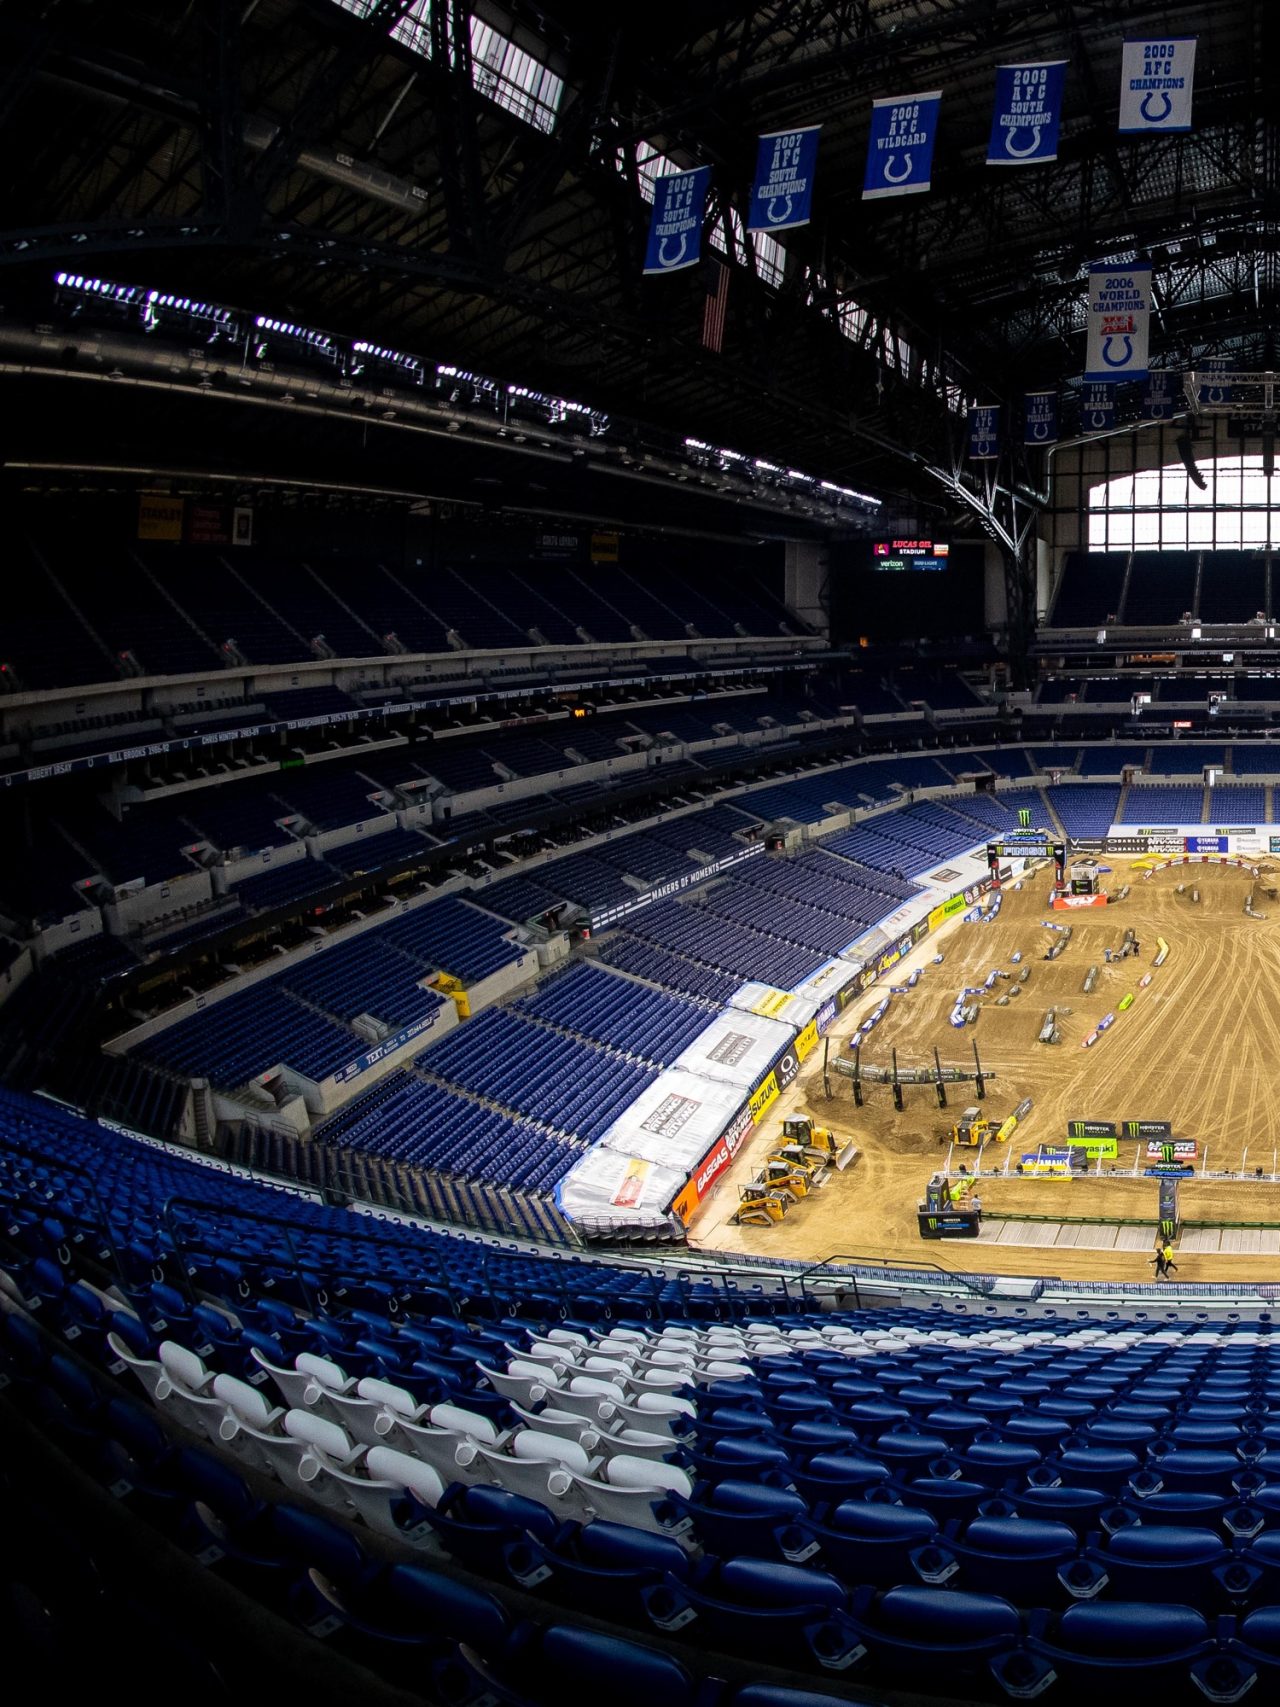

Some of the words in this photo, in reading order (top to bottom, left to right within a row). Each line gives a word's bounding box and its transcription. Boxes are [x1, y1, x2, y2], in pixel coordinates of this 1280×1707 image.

[1144, 45, 1174, 58] 2009
[1144, 61, 1171, 75] AFC
[1014, 69, 1047, 84] 2009
[1130, 78, 1184, 90] CHAMPIONS
[1012, 85, 1046, 101] AFC
[891, 105, 919, 121] 2008
[1010, 101, 1043, 114] SOUTH
[1000, 112, 1052, 127] CHAMPIONS
[889, 120, 917, 136] AFC
[774, 134, 802, 150] 2007
[877, 132, 926, 149] WILDCARD
[771, 147, 800, 169] AFC
[769, 167, 797, 183] SOUTH
[668, 176, 694, 193] 2006
[757, 178, 806, 199] CHAMPIONS
[665, 191, 693, 209] AFC
[663, 207, 690, 222] SOUTH
[656, 216, 696, 235] CHAMPIONS
[1105, 279, 1134, 289] 2006
[1099, 290, 1140, 300] WORLD
[1093, 301, 1144, 312] CHAMPIONS
[1084, 402, 1113, 411] WILDCARD
[892, 540, 918, 548] LUCAS
[202, 732, 218, 744] CHRIS
[108, 751, 122, 763] BILL
[124, 747, 146, 761] BROOKS
[28, 766, 53, 781] ROBERT
[1003, 846, 1048, 856] FINISH
[651, 880, 679, 901] MAKERS
[680, 876, 689, 888] OF
[690, 862, 720, 883] MOMENTS
[751, 1078, 777, 1116] SUZUKI
[697, 1149, 729, 1193] GASGAS
